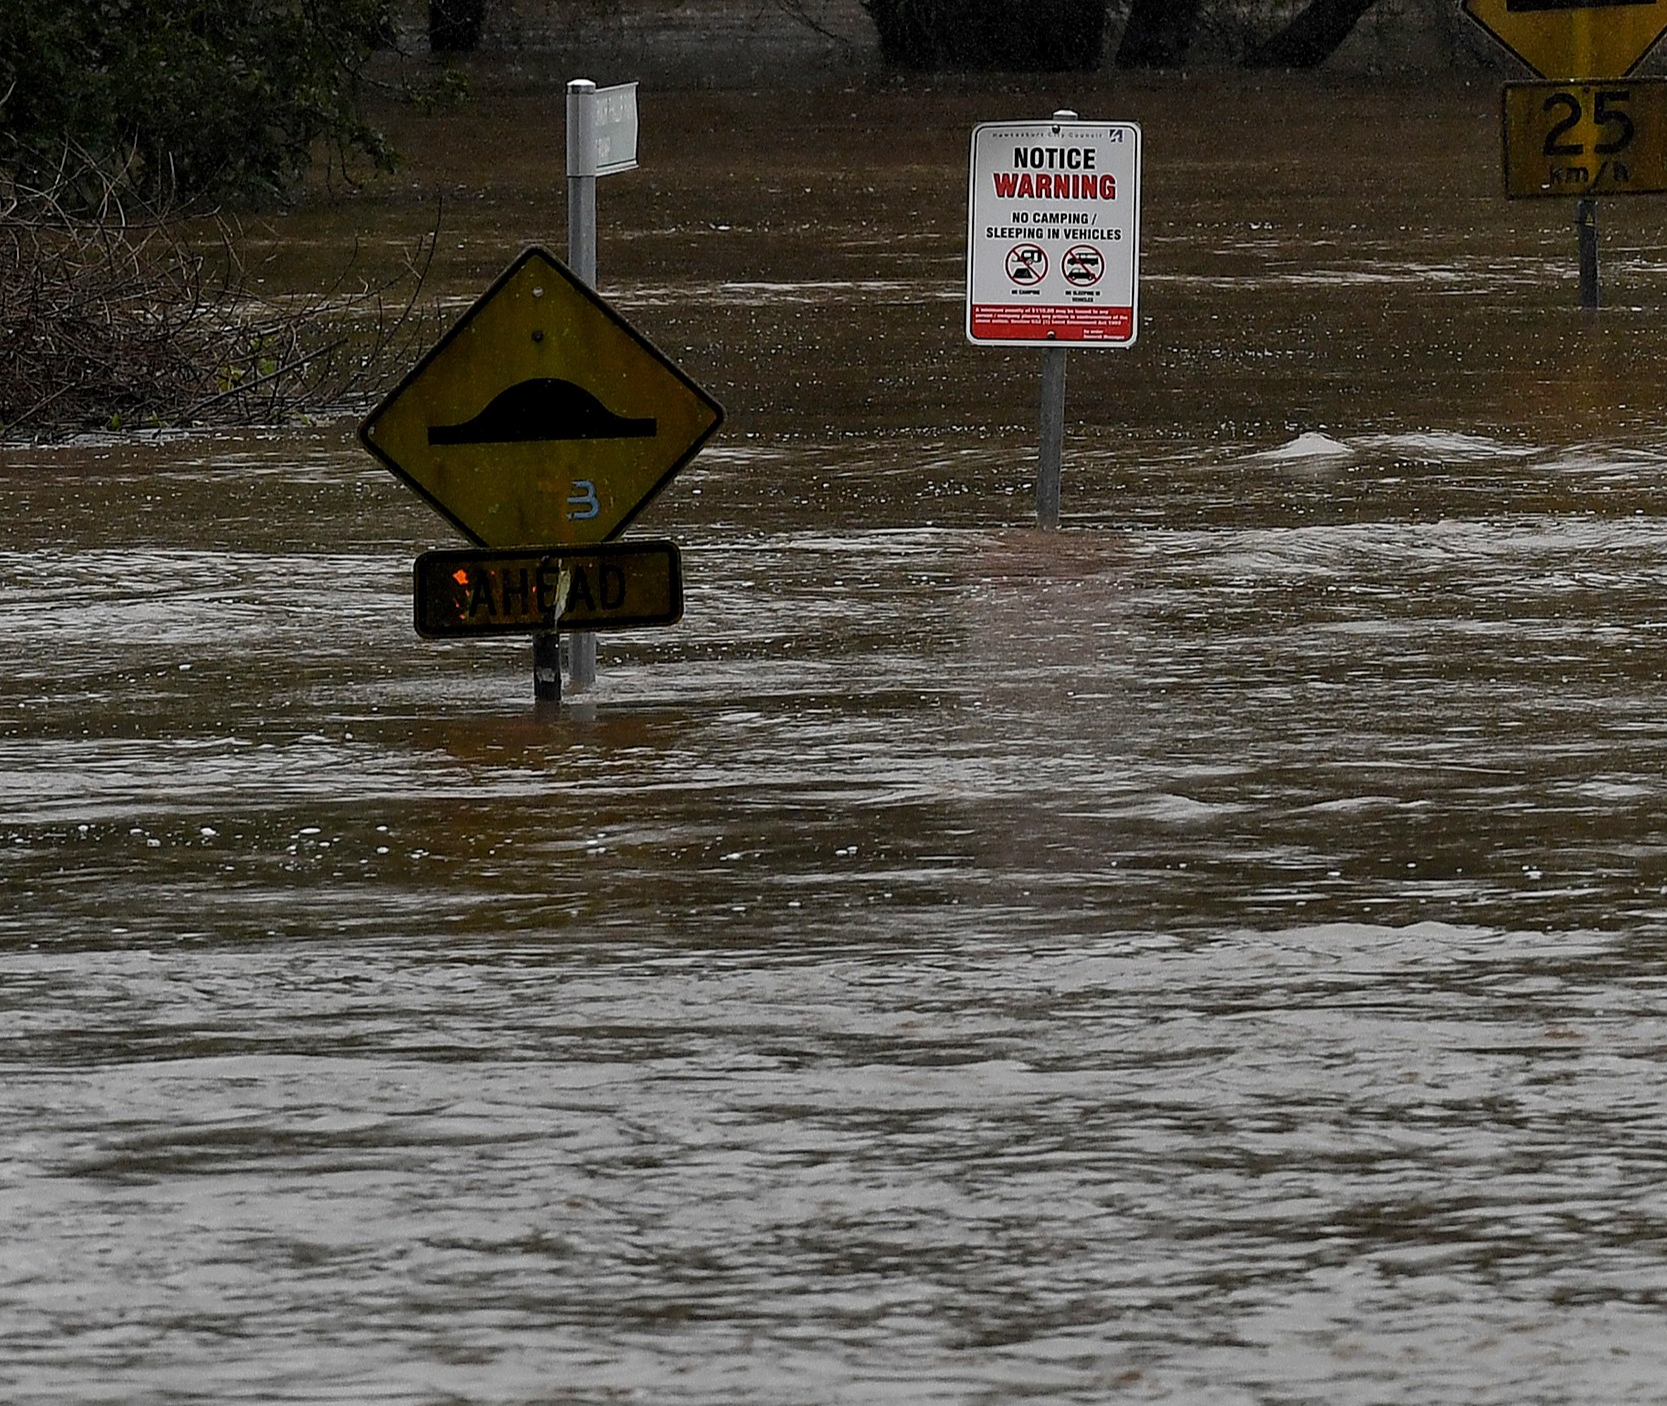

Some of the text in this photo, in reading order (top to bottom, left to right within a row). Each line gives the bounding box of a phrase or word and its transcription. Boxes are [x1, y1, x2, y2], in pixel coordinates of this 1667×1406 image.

[1542, 90, 1634, 157] 25
[1014, 148, 1096, 170] NOTICE
[994, 173, 1116, 199] WARNING
[1549, 163, 1631, 192] km/h
[1012, 212, 1098, 225] NO CAMPING /
[986, 228, 1122, 241] SLEEPING IN VEHICLES
[469, 563, 627, 618] AHEAD
